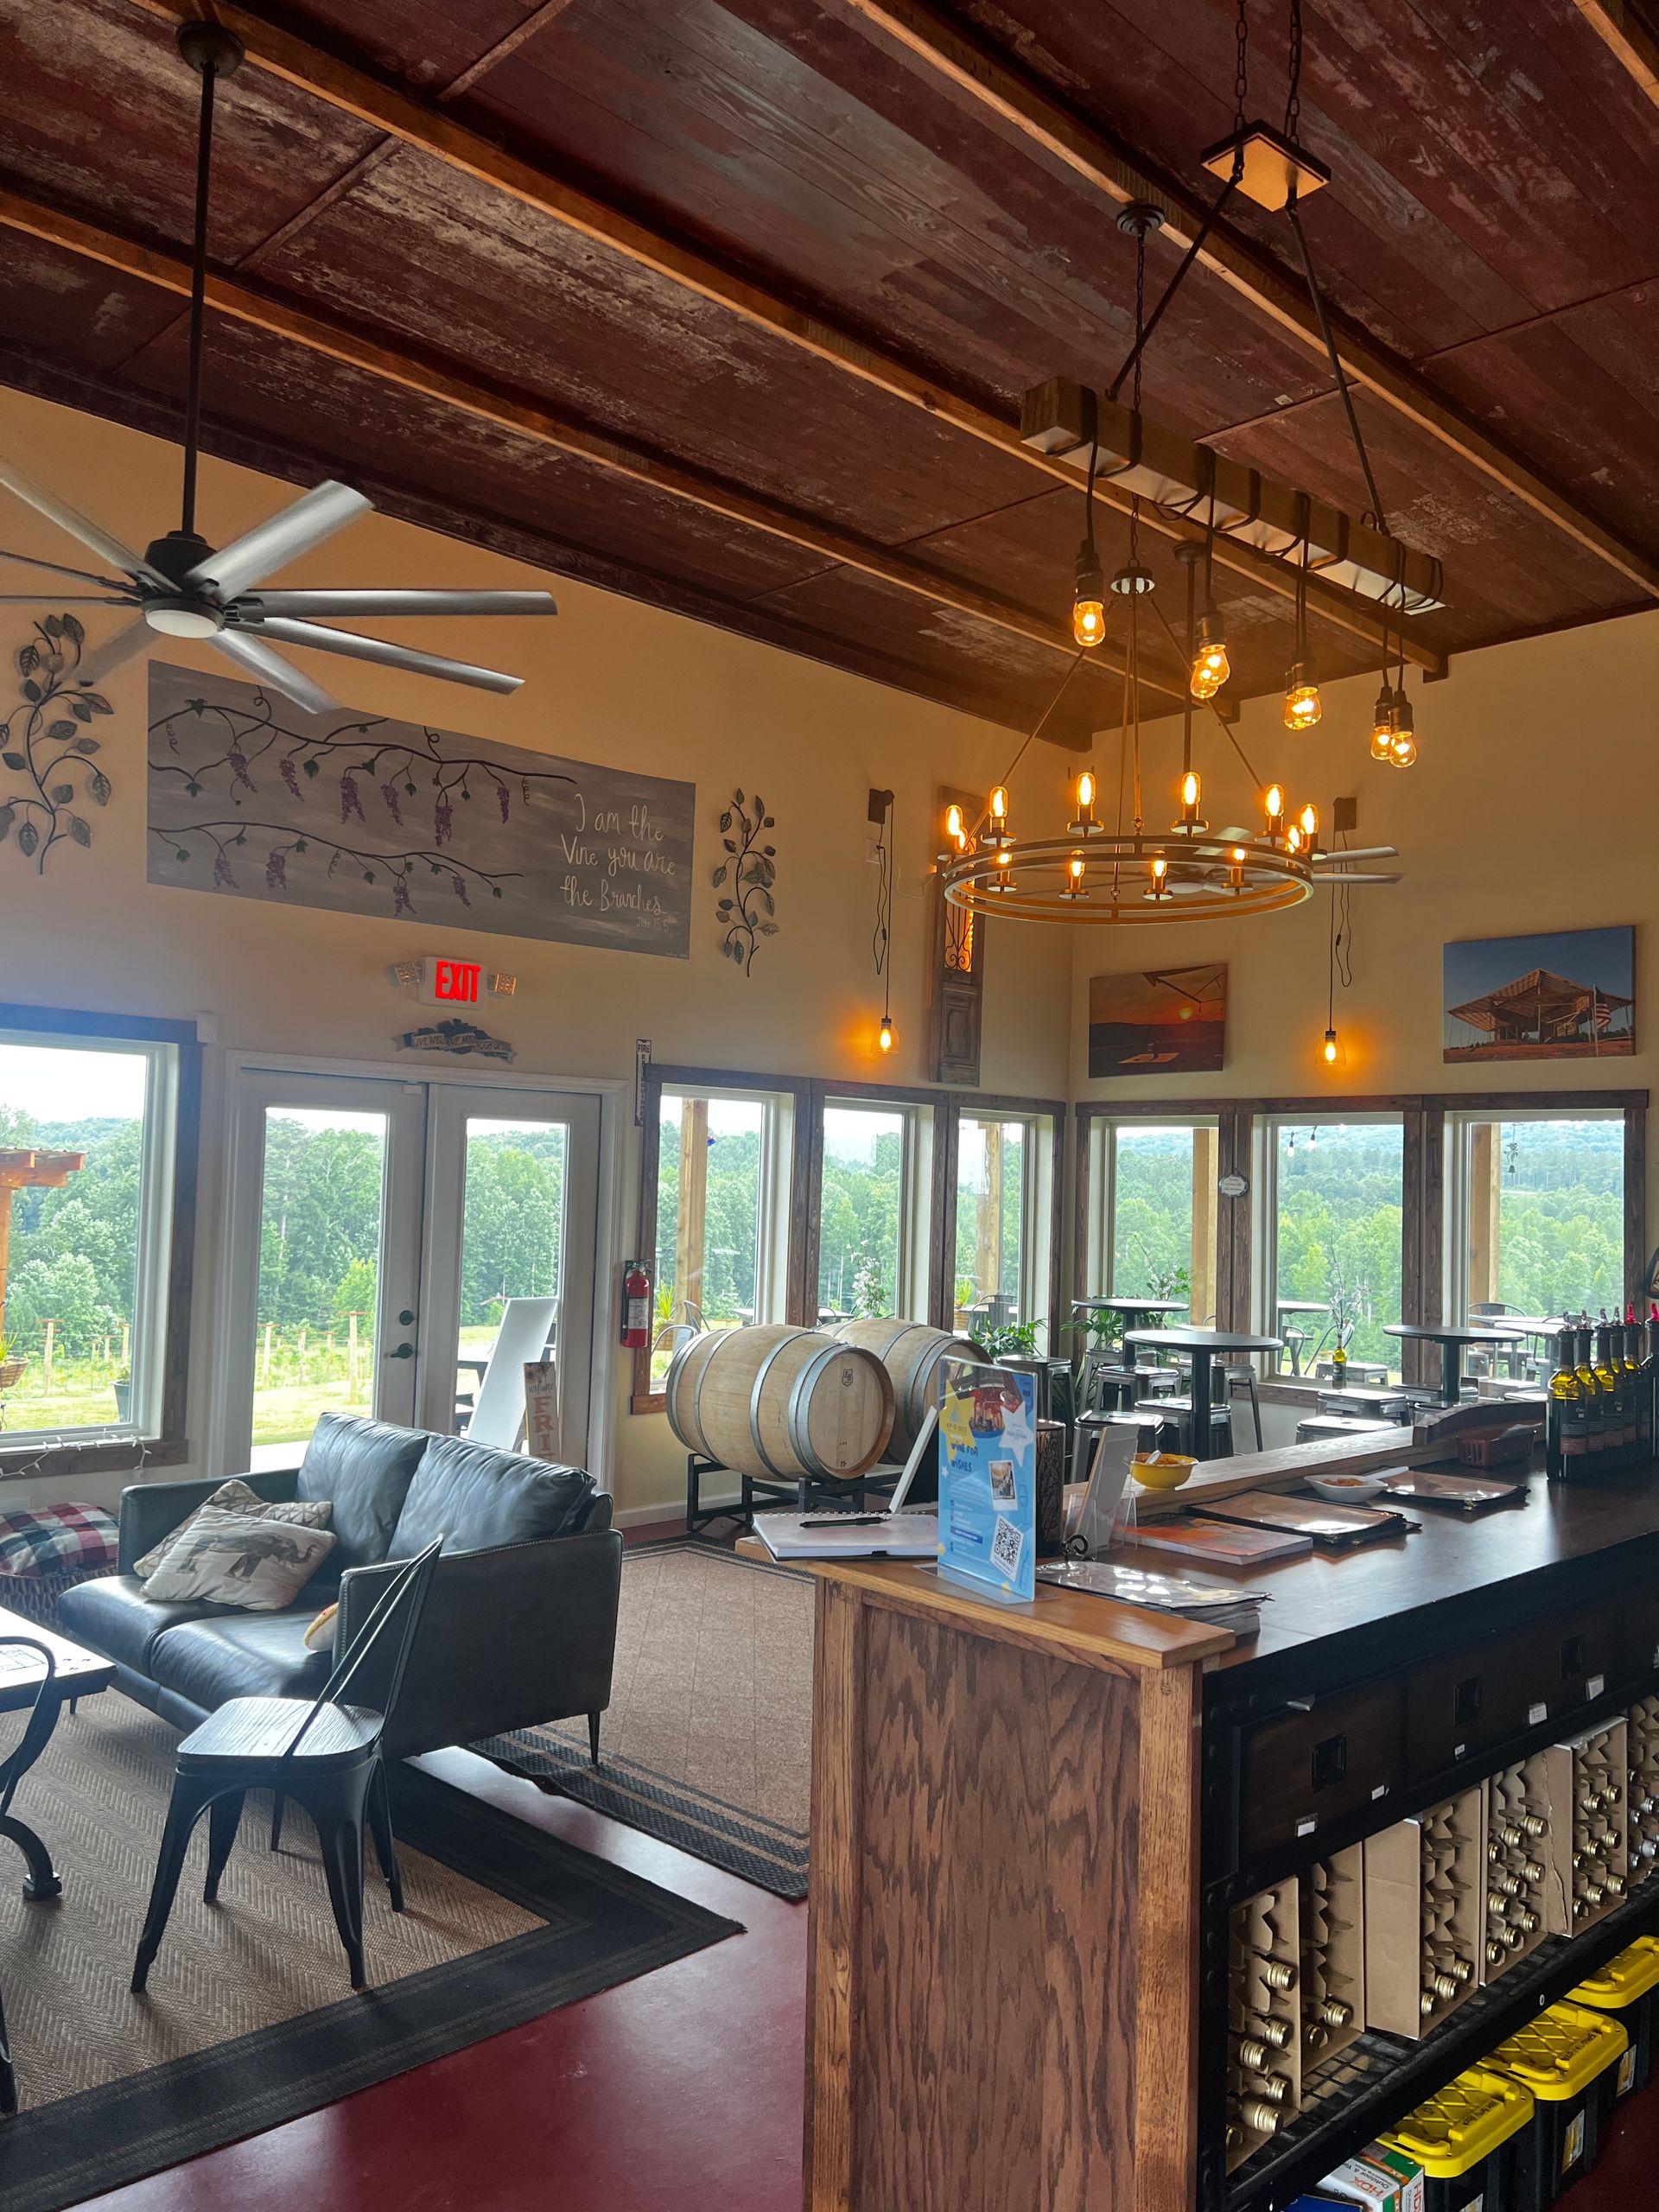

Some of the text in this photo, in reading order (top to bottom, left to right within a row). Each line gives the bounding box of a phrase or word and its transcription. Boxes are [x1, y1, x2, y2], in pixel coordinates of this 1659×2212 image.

[574, 793, 664, 842] I am the
[561, 833, 677, 877] Vine you are
[560, 874, 666, 916] the Branches
[435, 960, 482, 1003] EXIT
[533, 1396, 555, 1458] FRI
[1360, 2171, 1389, 2190] Outdoor
